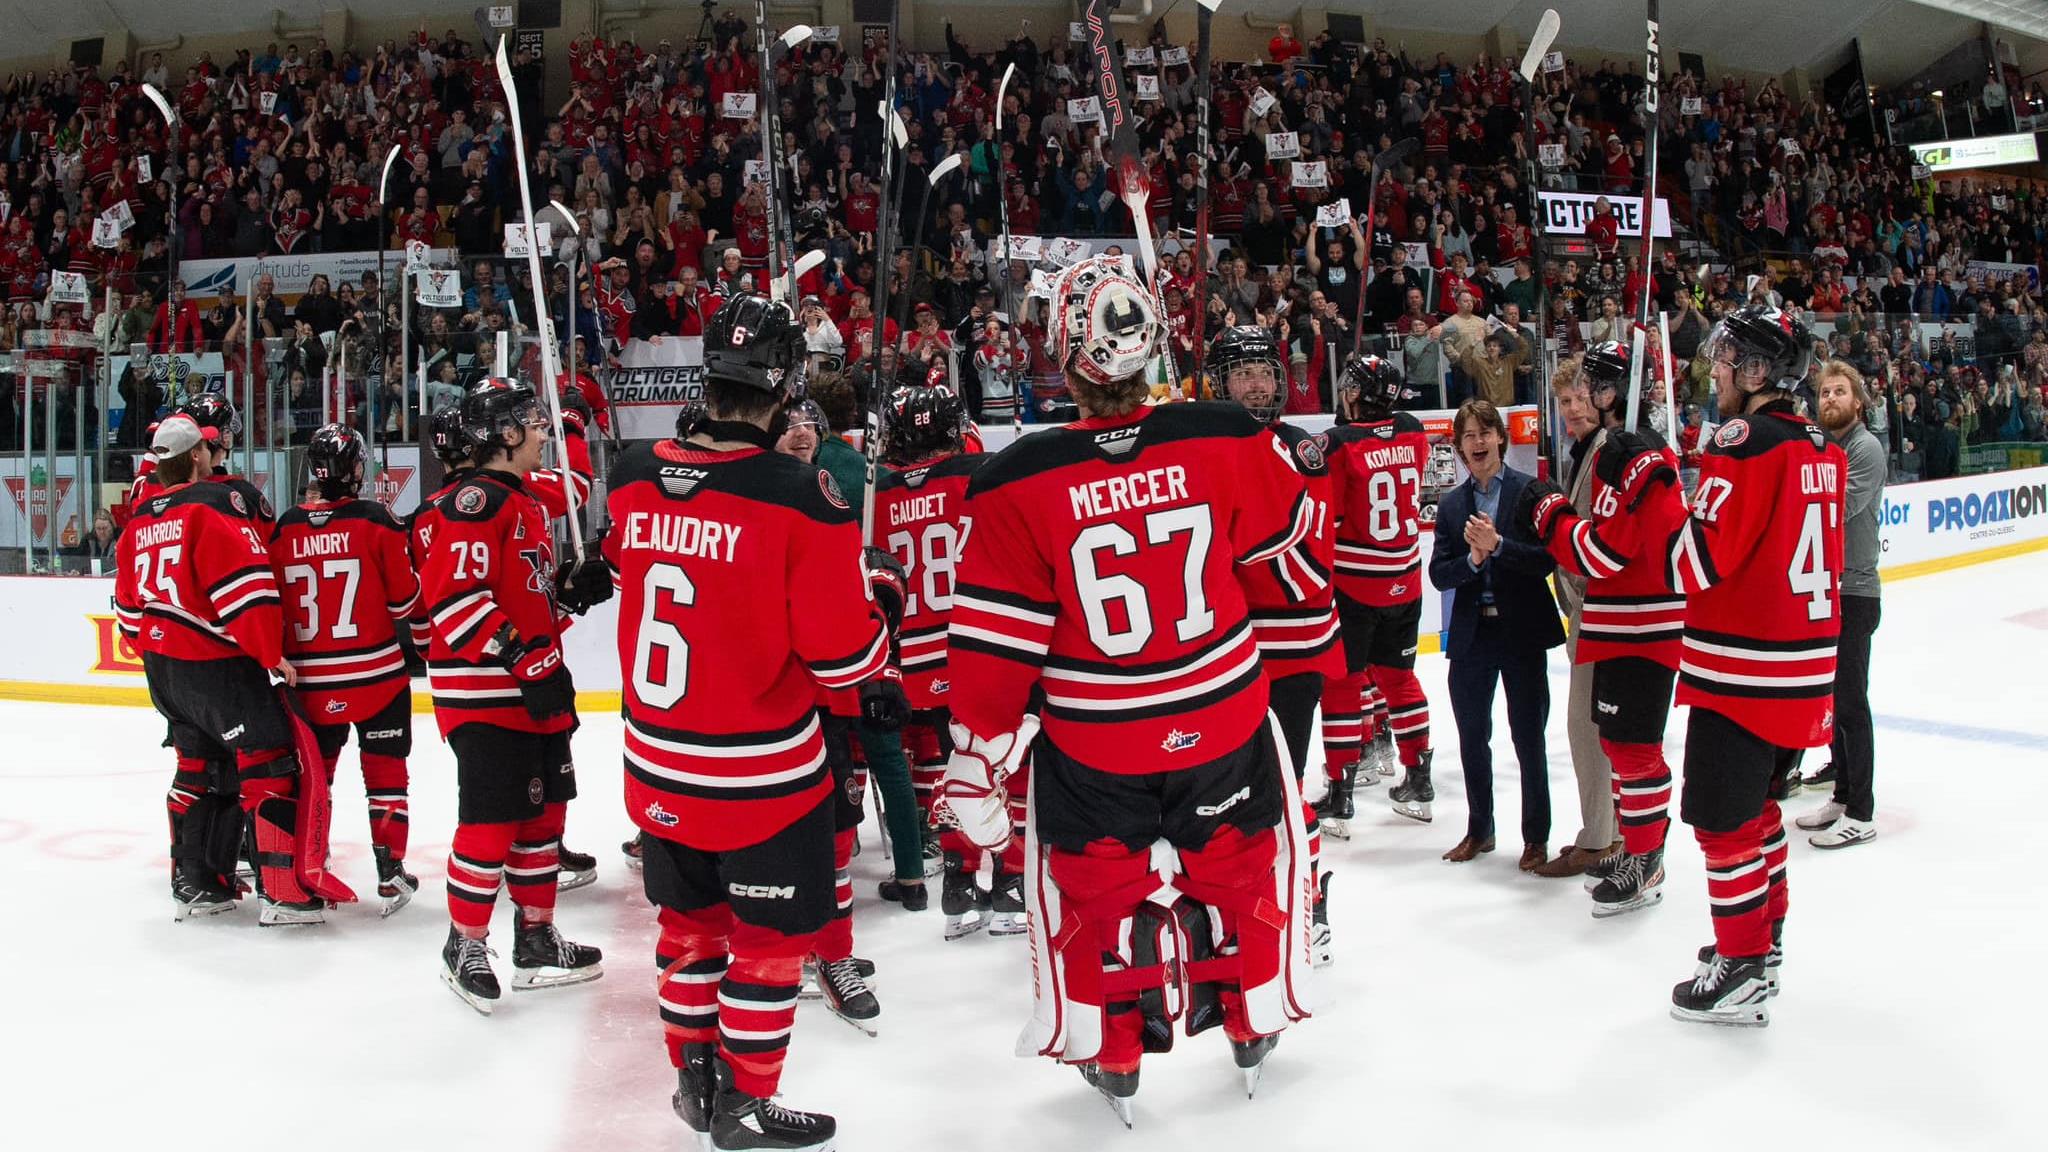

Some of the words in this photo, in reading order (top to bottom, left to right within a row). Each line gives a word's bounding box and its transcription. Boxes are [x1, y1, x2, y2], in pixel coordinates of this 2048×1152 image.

[519, 33, 542, 43] SECT.
[1086, 0, 1123, 141] VAPOR
[1646, 19, 1658, 113] CCM
[771, 114, 784, 171] CCM
[1540, 199, 1640, 230] ICTORE
[732, 326, 747, 345] 6
[609, 367, 704, 385] VOLTIGEU
[612, 385, 705, 401] DRUMMO
[914, 412, 930, 426] 28
[1094, 426, 1142, 443] CCM
[436, 433, 447, 444] 71
[865, 423, 876, 486] CCM
[316, 468, 329, 479] 37
[659, 466, 709, 479] CCM
[904, 467, 931, 479] CCM
[1364, 445, 1415, 469] KOMAROV
[889, 492, 947, 526] GAUDET
[1068, 465, 1190, 521] MERCER
[1368, 467, 1421, 542] 83
[1693, 476, 1733, 522] 47
[1928, 484, 2047, 533] PROAXION
[135, 518, 183, 551] CHARROIS
[292, 532, 350, 558] LANDRY
[450, 541, 489, 580] 79
[887, 522, 958, 617] 28
[1787, 502, 1838, 622] 4
[1069, 502, 1215, 659] 67
[284, 558, 361, 642] 37
[631, 560, 697, 713] 6
[365, 728, 403, 740] CCM
[1195, 786, 1251, 817] CCM
[729, 882, 796, 900] CCM
[1302, 877, 1313, 966] BAUER
